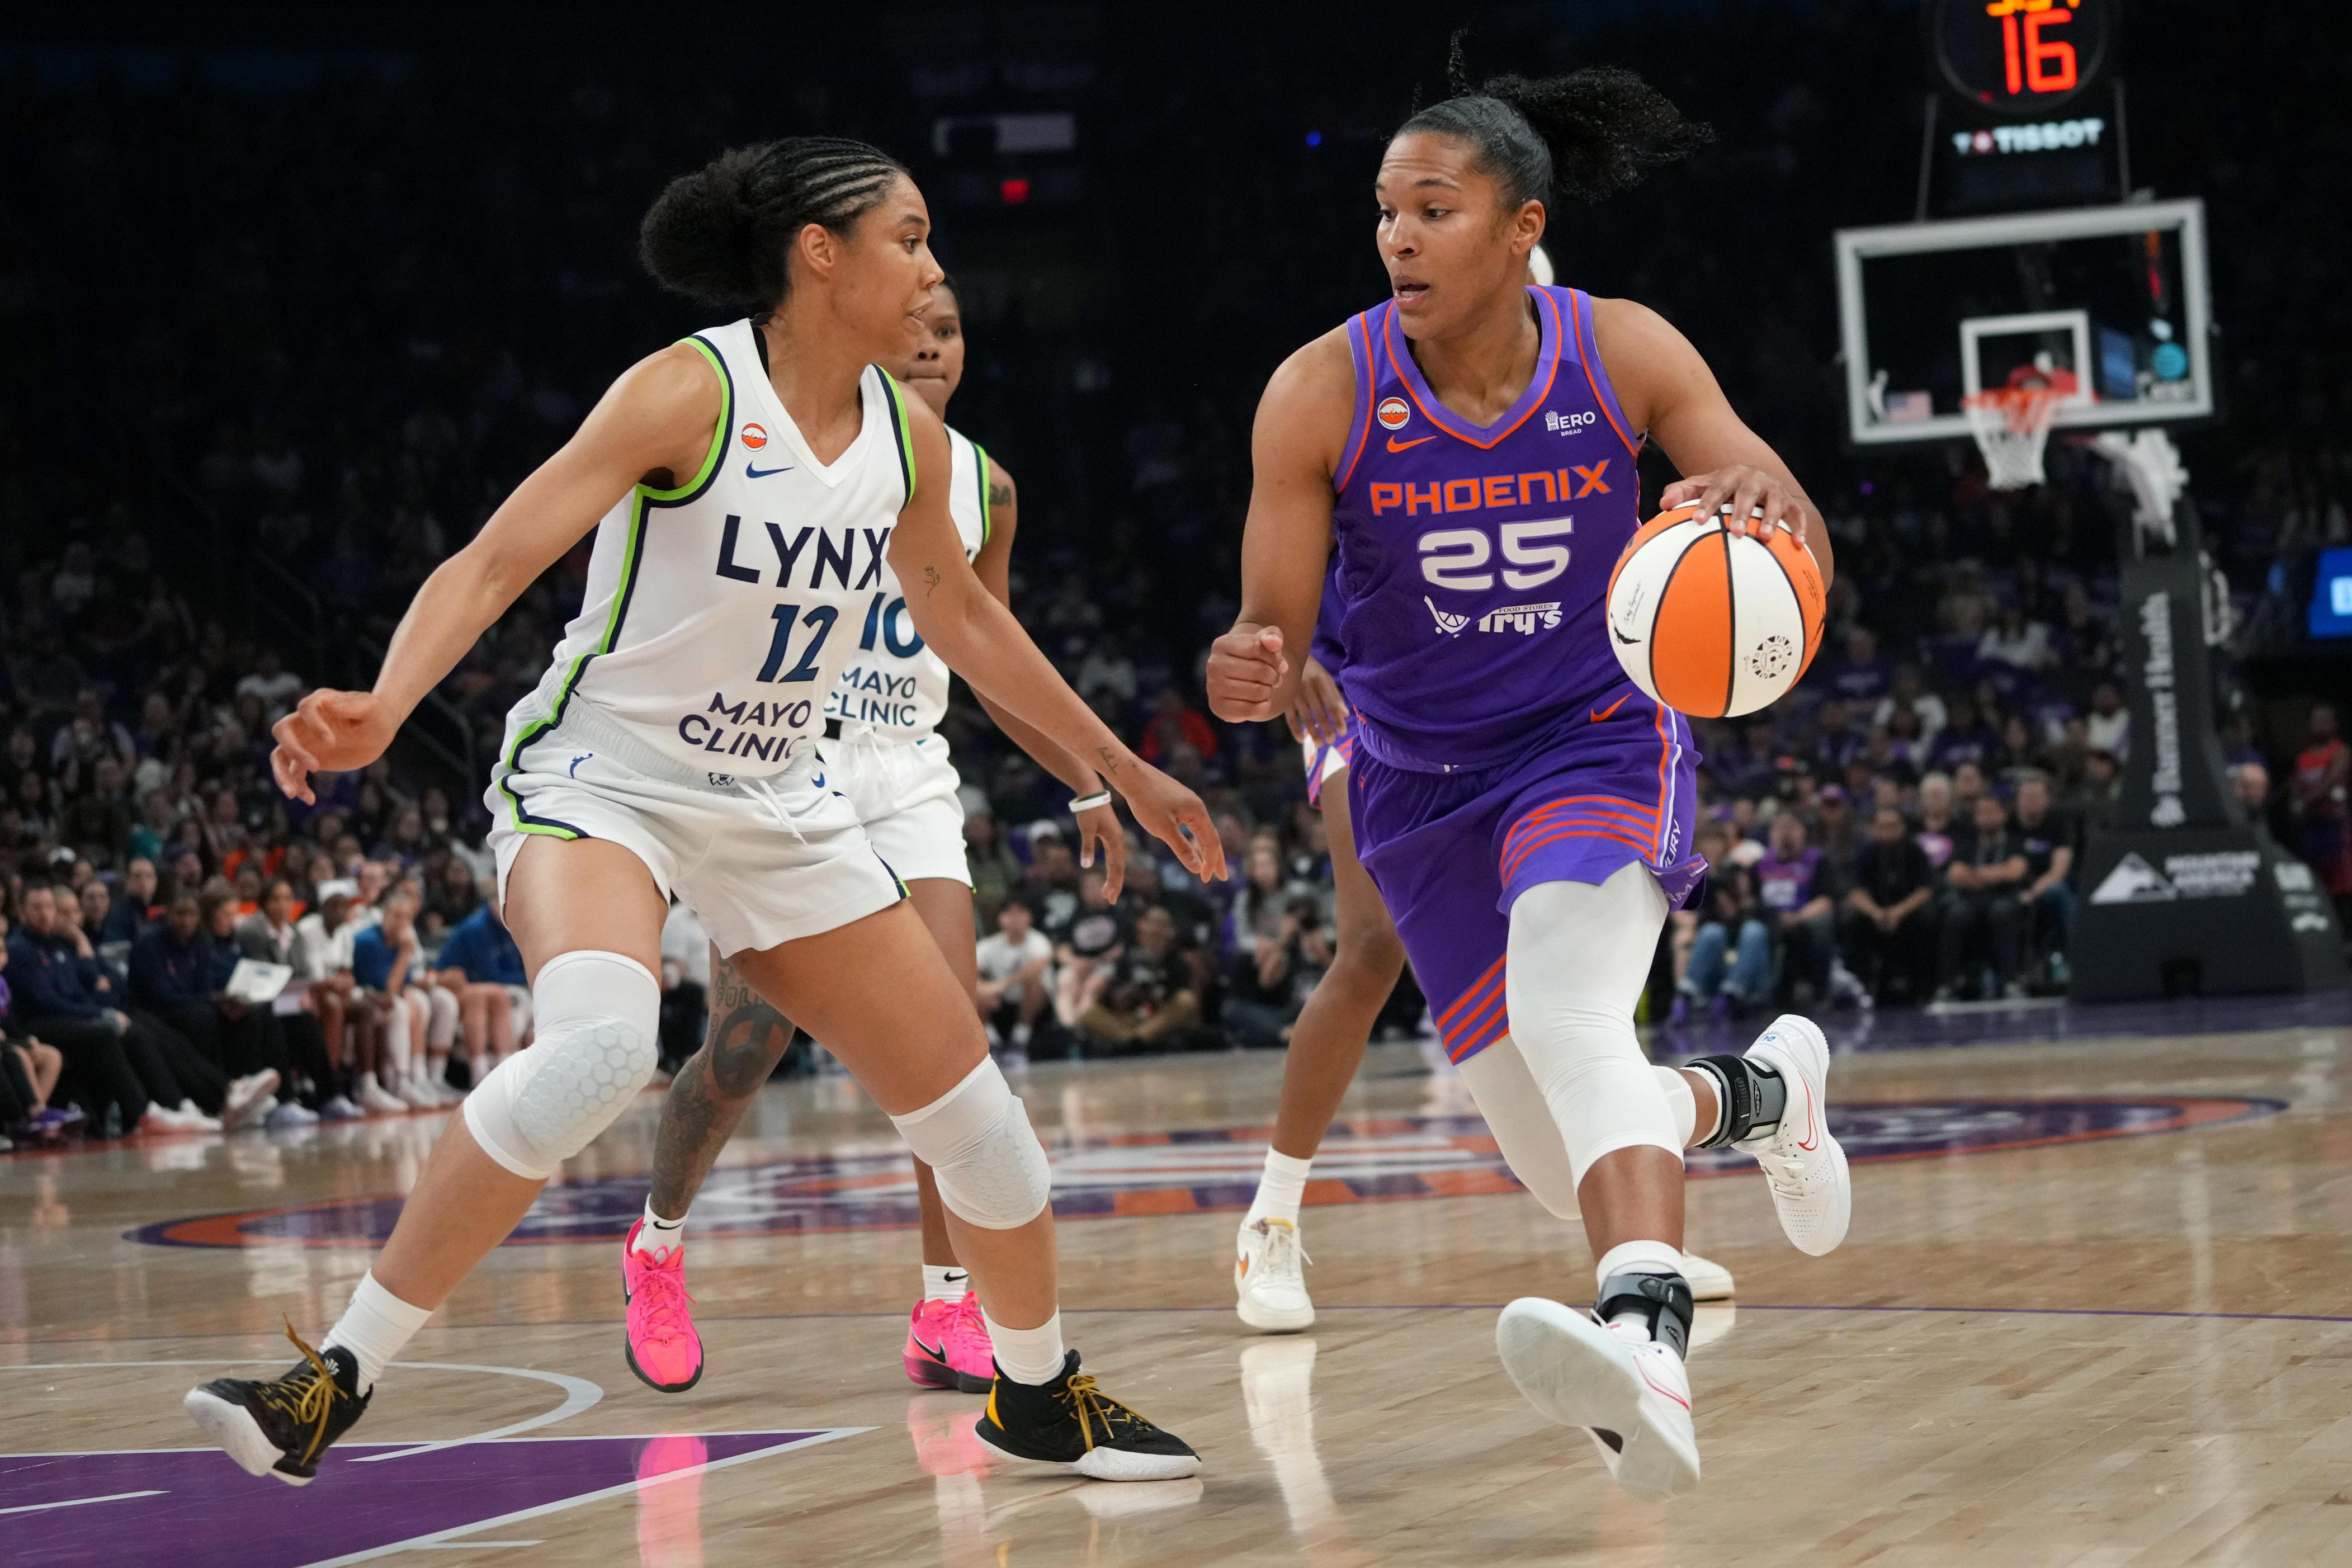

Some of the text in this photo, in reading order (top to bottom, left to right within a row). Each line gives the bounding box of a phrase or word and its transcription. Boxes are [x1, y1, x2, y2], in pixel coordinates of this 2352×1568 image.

[2002, 8, 2077, 95] 16
[1993, 117, 2104, 154] TISSOT
[1545, 410, 1596, 432] HERO
[1561, 428, 1582, 437] BREAD
[1369, 458, 1612, 516] PHOENIX
[716, 514, 891, 591] LYNX
[1417, 515, 1574, 592] 25
[859, 592, 925, 659] 10
[1523, 603, 1553, 612] STORES
[756, 604, 839, 683] 12
[707, 692, 811, 729] MAYO
